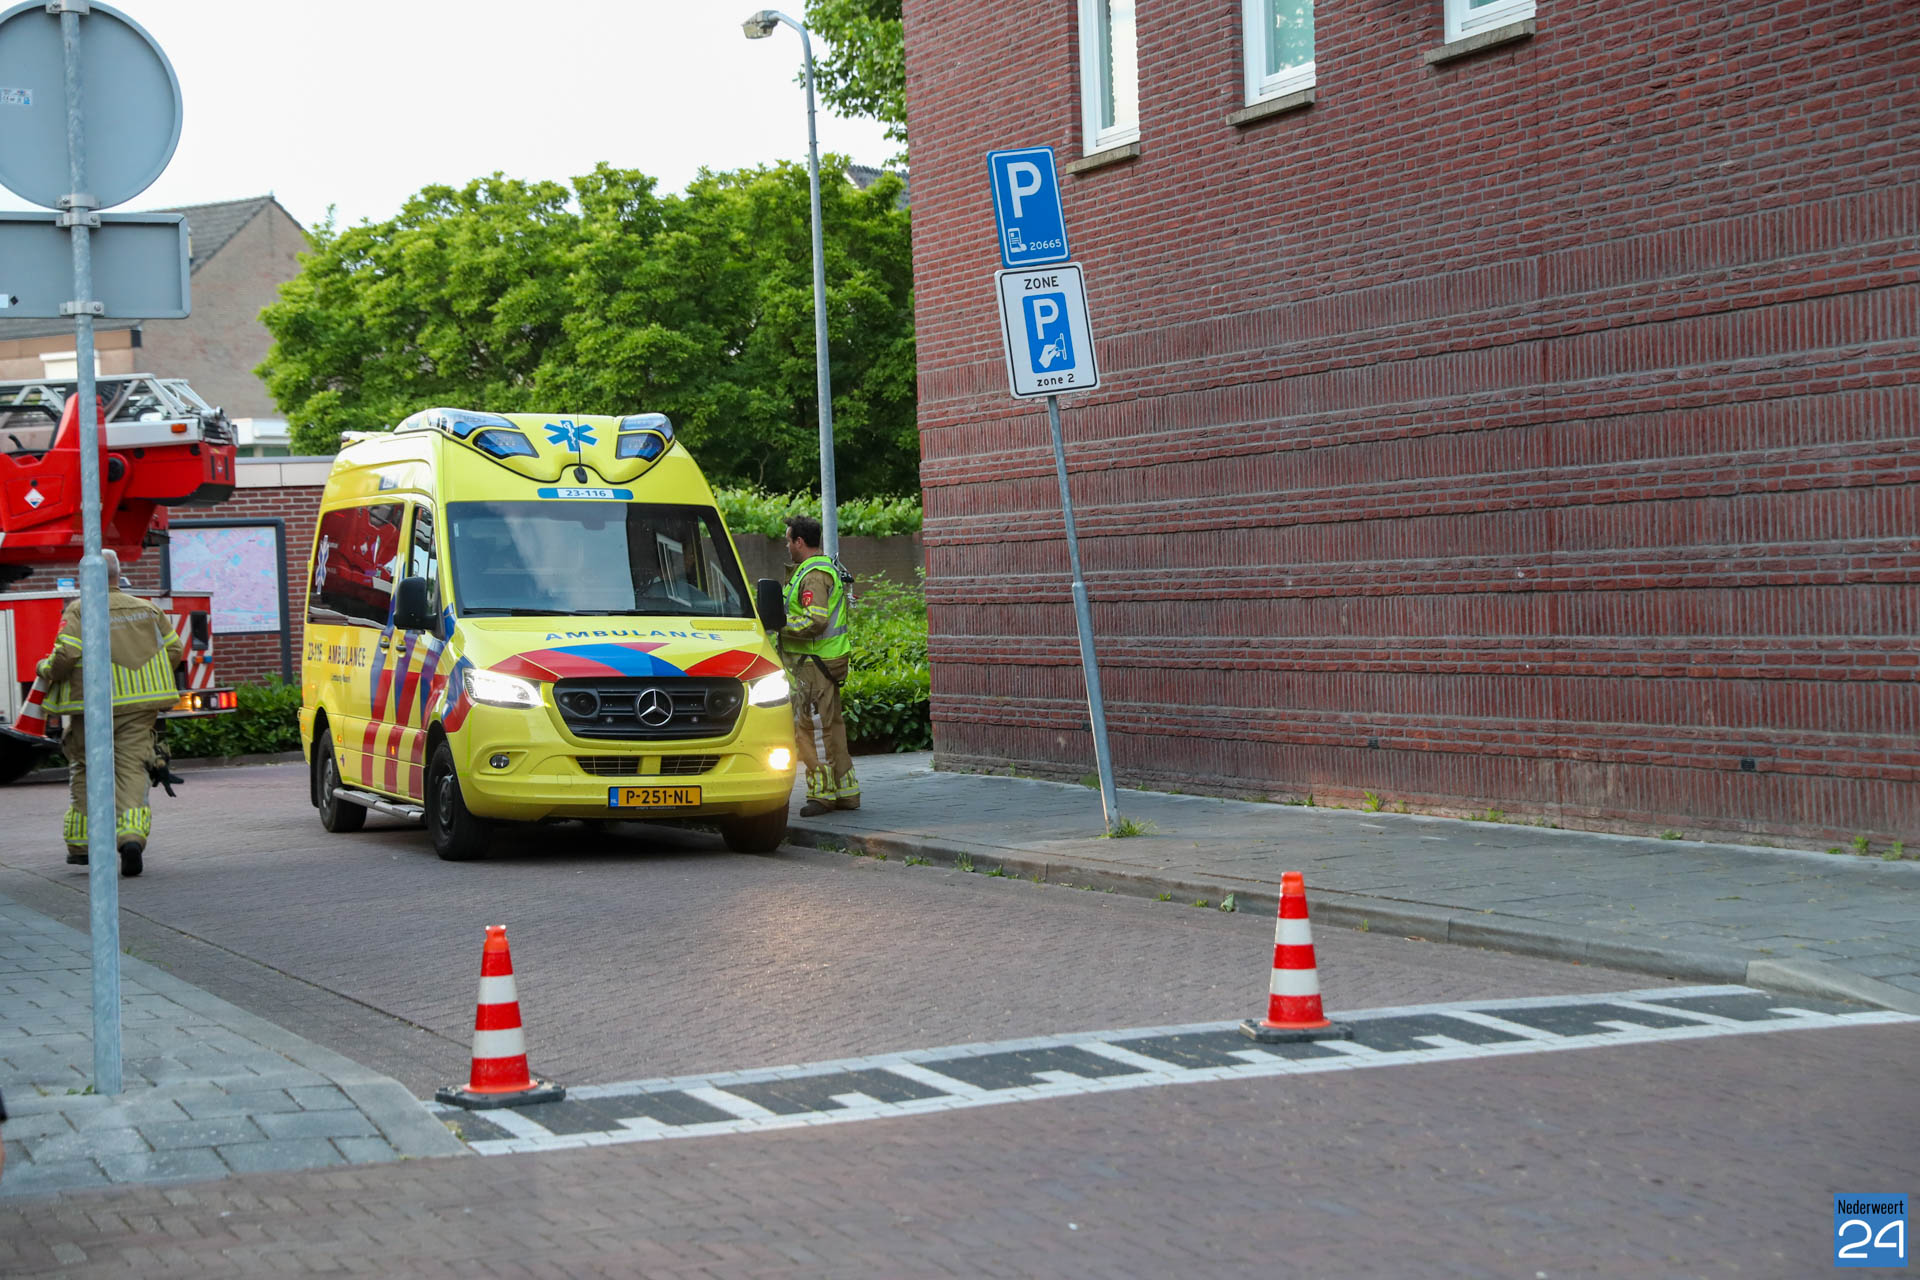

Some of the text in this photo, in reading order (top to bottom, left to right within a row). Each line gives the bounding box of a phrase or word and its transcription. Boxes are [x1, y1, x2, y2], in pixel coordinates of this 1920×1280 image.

[1006, 161, 1042, 218] P
[1030, 238, 1062, 251] 20665
[1024, 275, 1060, 290] ZONE
[1032, 298, 1059, 340] P
[1036, 373, 1075, 387] zone 2
[565, 489, 607, 497] 23-116
[545, 629, 725, 642] AMBULANCE
[327, 644, 366, 668] AMBULANCE
[626, 789, 694, 805] P-251-NL
